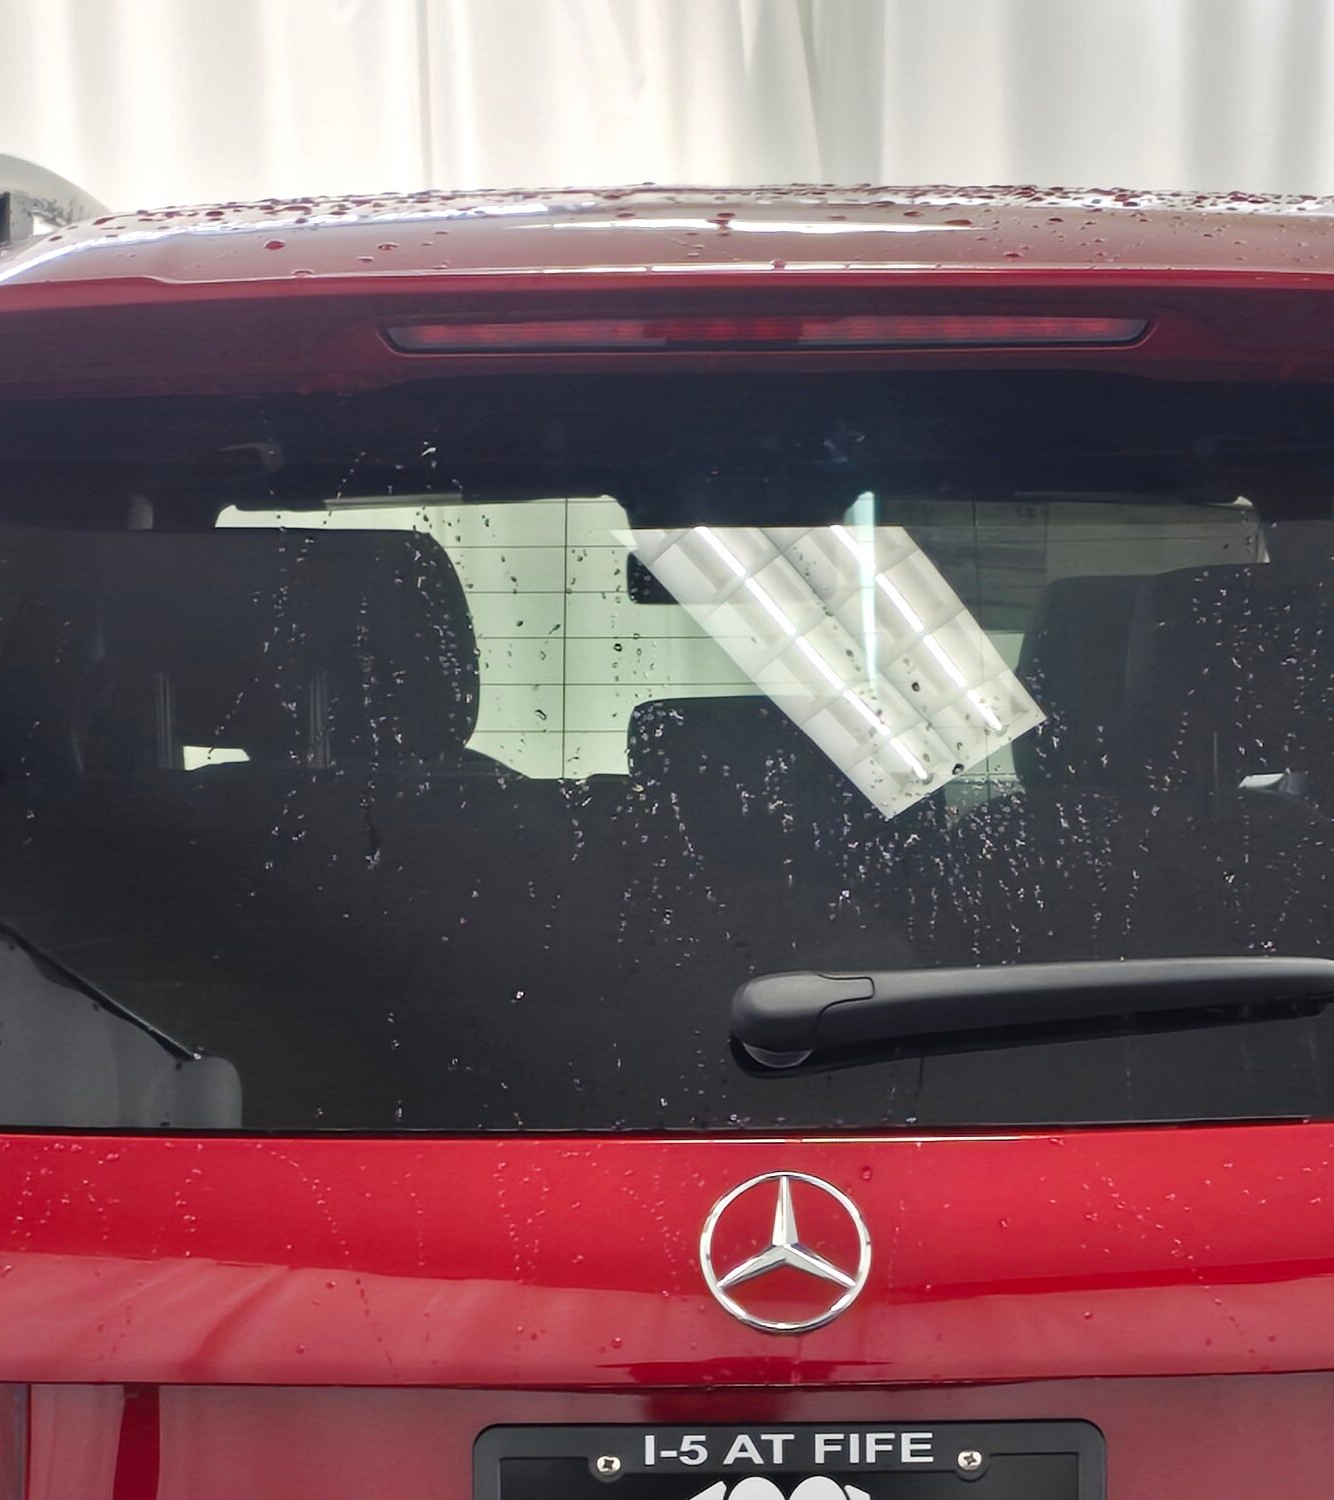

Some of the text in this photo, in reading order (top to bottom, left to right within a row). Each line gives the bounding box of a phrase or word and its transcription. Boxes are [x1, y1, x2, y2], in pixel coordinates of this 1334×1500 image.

[644, 1432, 934, 1465] I-5 AT FIFE
